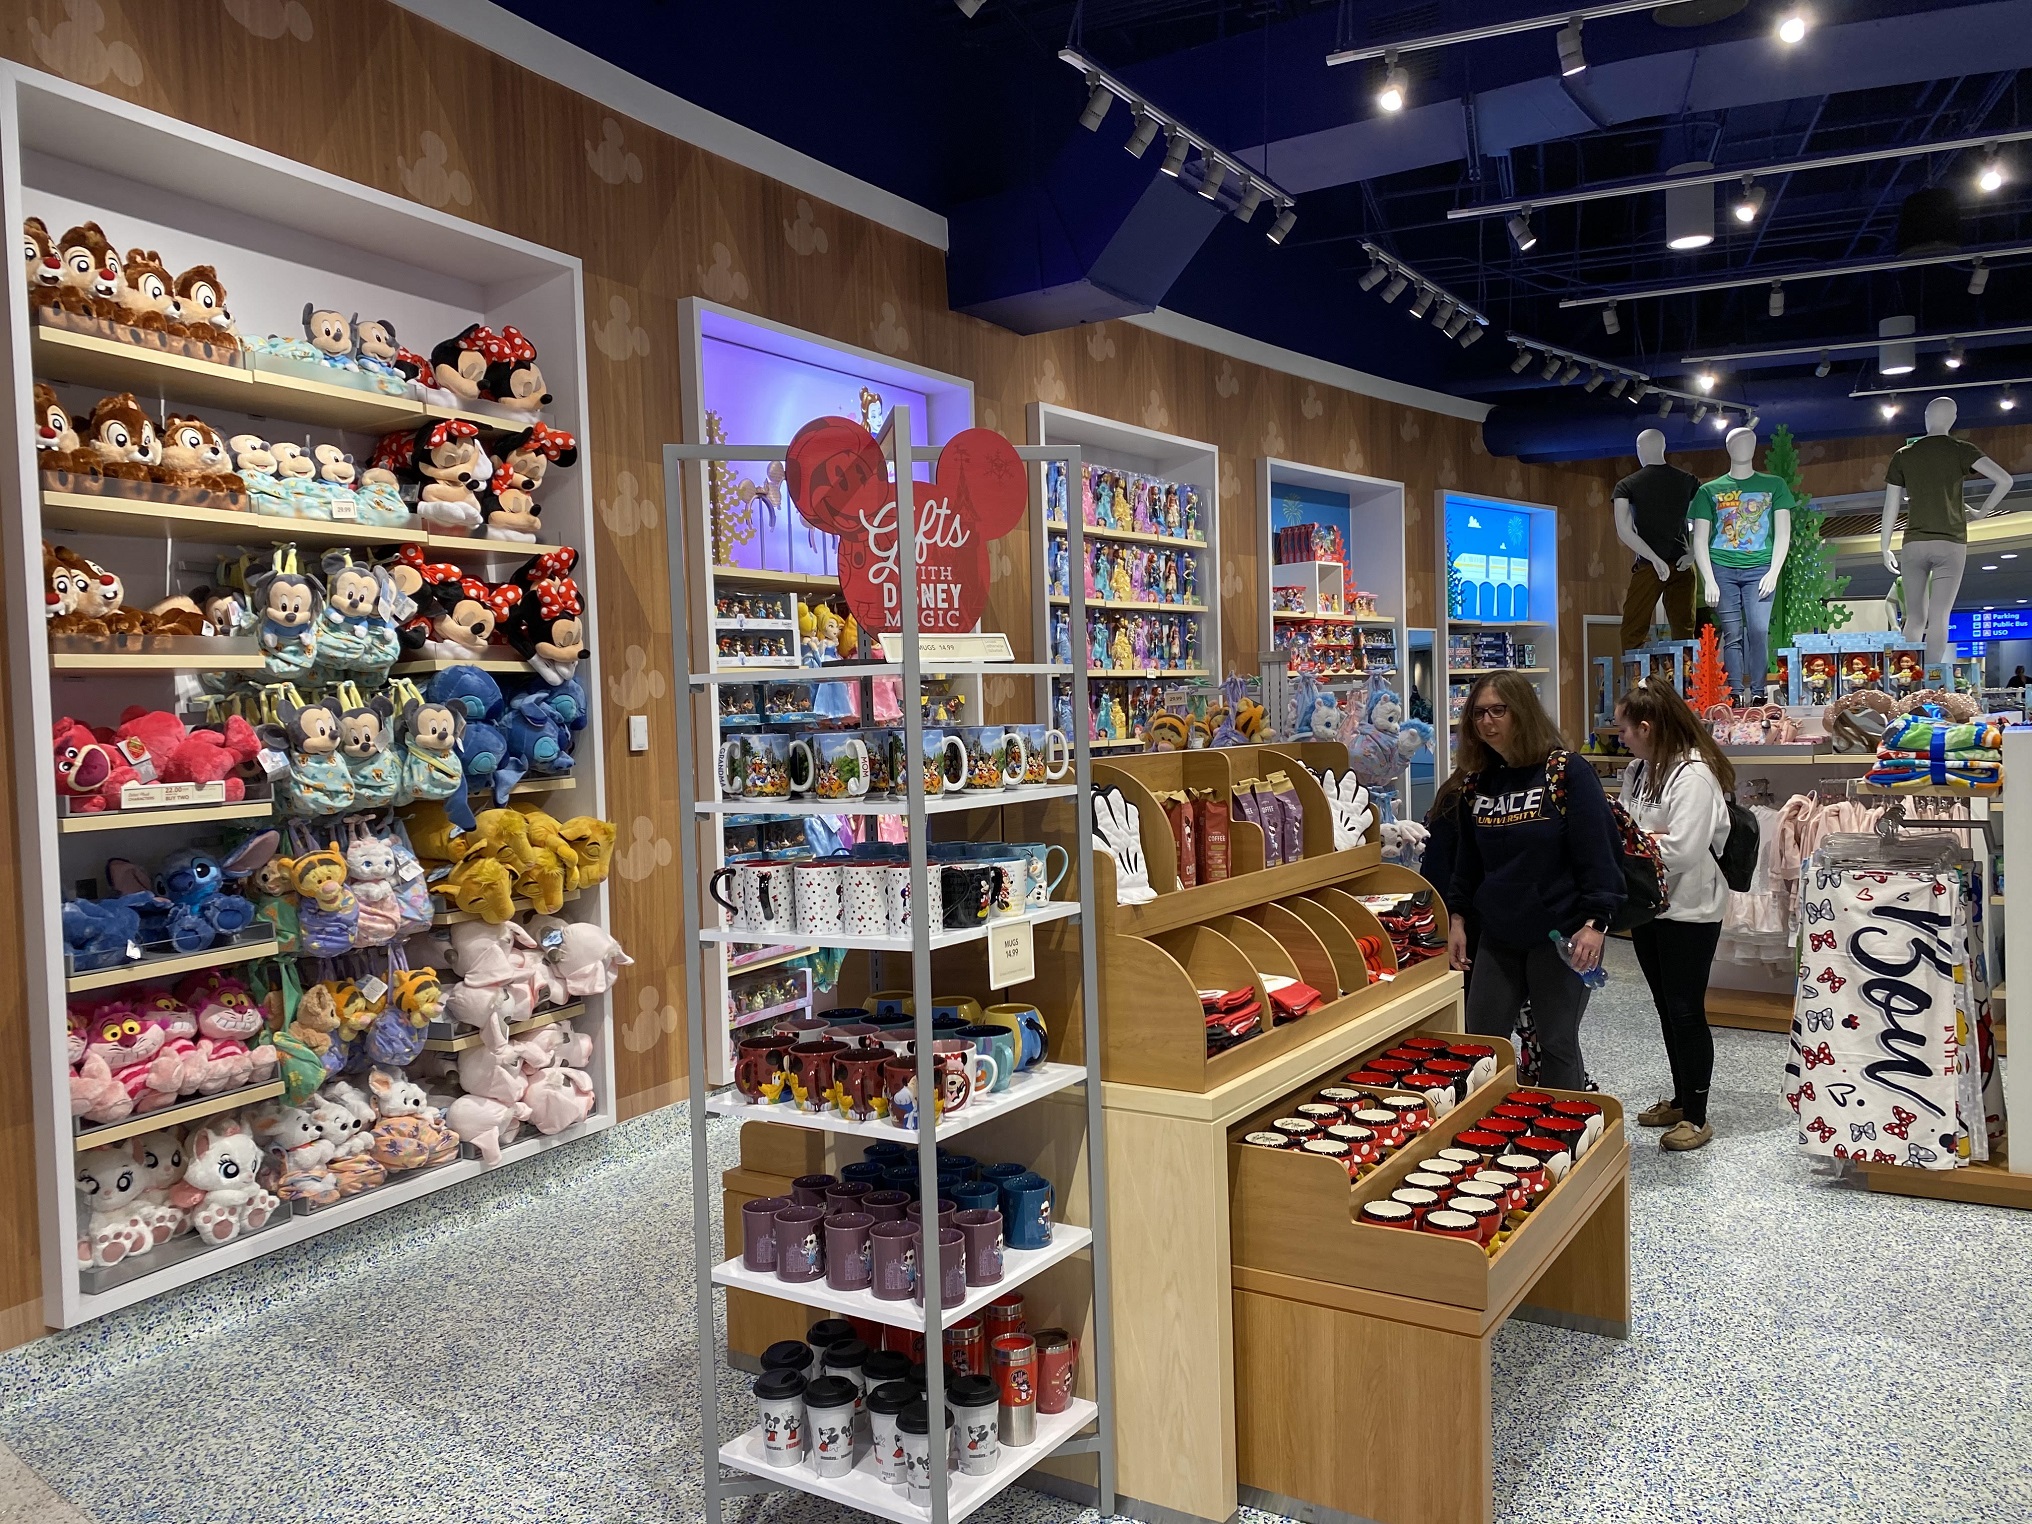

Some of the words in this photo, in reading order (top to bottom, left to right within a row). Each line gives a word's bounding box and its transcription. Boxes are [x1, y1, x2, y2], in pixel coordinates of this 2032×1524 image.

[1715, 490, 1742, 502] TOY
[859, 497, 970, 584] Gfts
[916, 566, 952, 580] ITH
[883, 583, 962, 609] DNEY
[884, 610, 960, 627] MGIC
[718, 747, 726, 788] GRANDMA
[860, 756, 869, 778] MOM
[1472, 788, 1543, 816] PACE
[1004, 938, 1019, 949] MUGS
